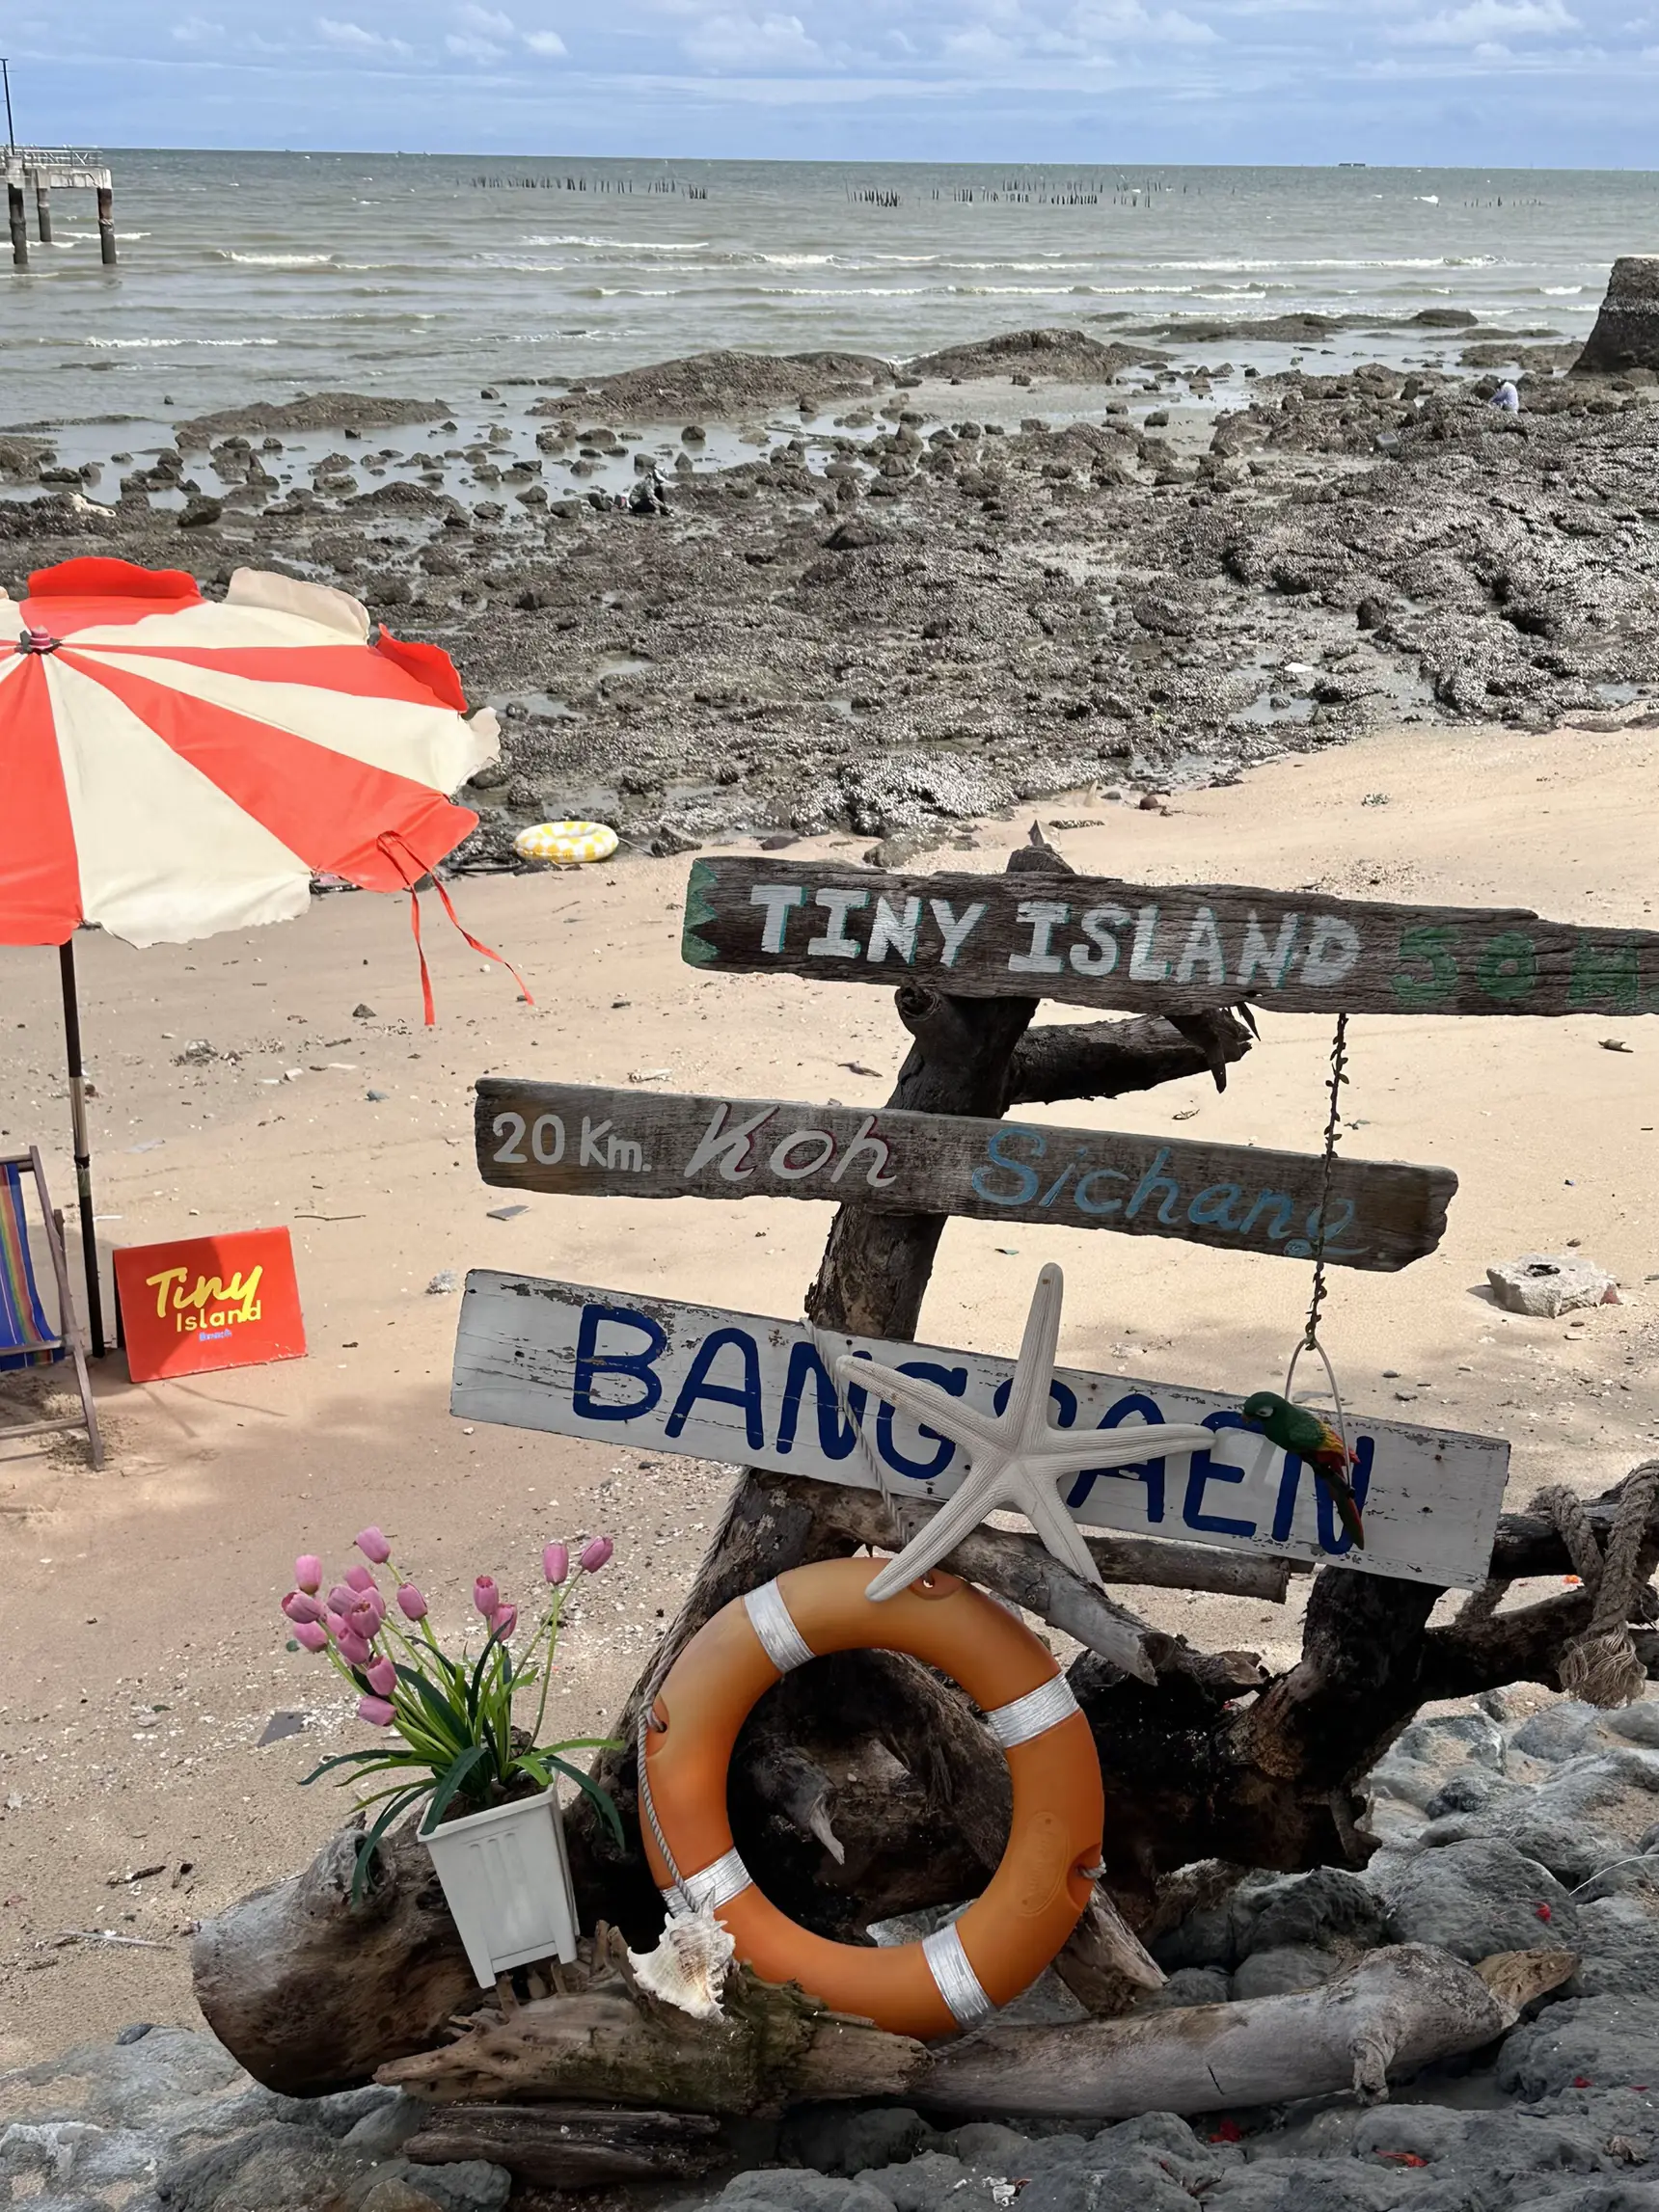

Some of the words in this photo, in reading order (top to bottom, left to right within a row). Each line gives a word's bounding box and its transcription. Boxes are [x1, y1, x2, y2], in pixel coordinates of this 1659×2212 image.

[749, 884, 989, 968] TINY
[1008, 902, 1361, 988] ISLAND
[492, 1111, 566, 1166] 20
[683, 1101, 898, 1188] Koh
[146, 1264, 263, 1322] Tiny
[176, 1299, 262, 1333] Island
